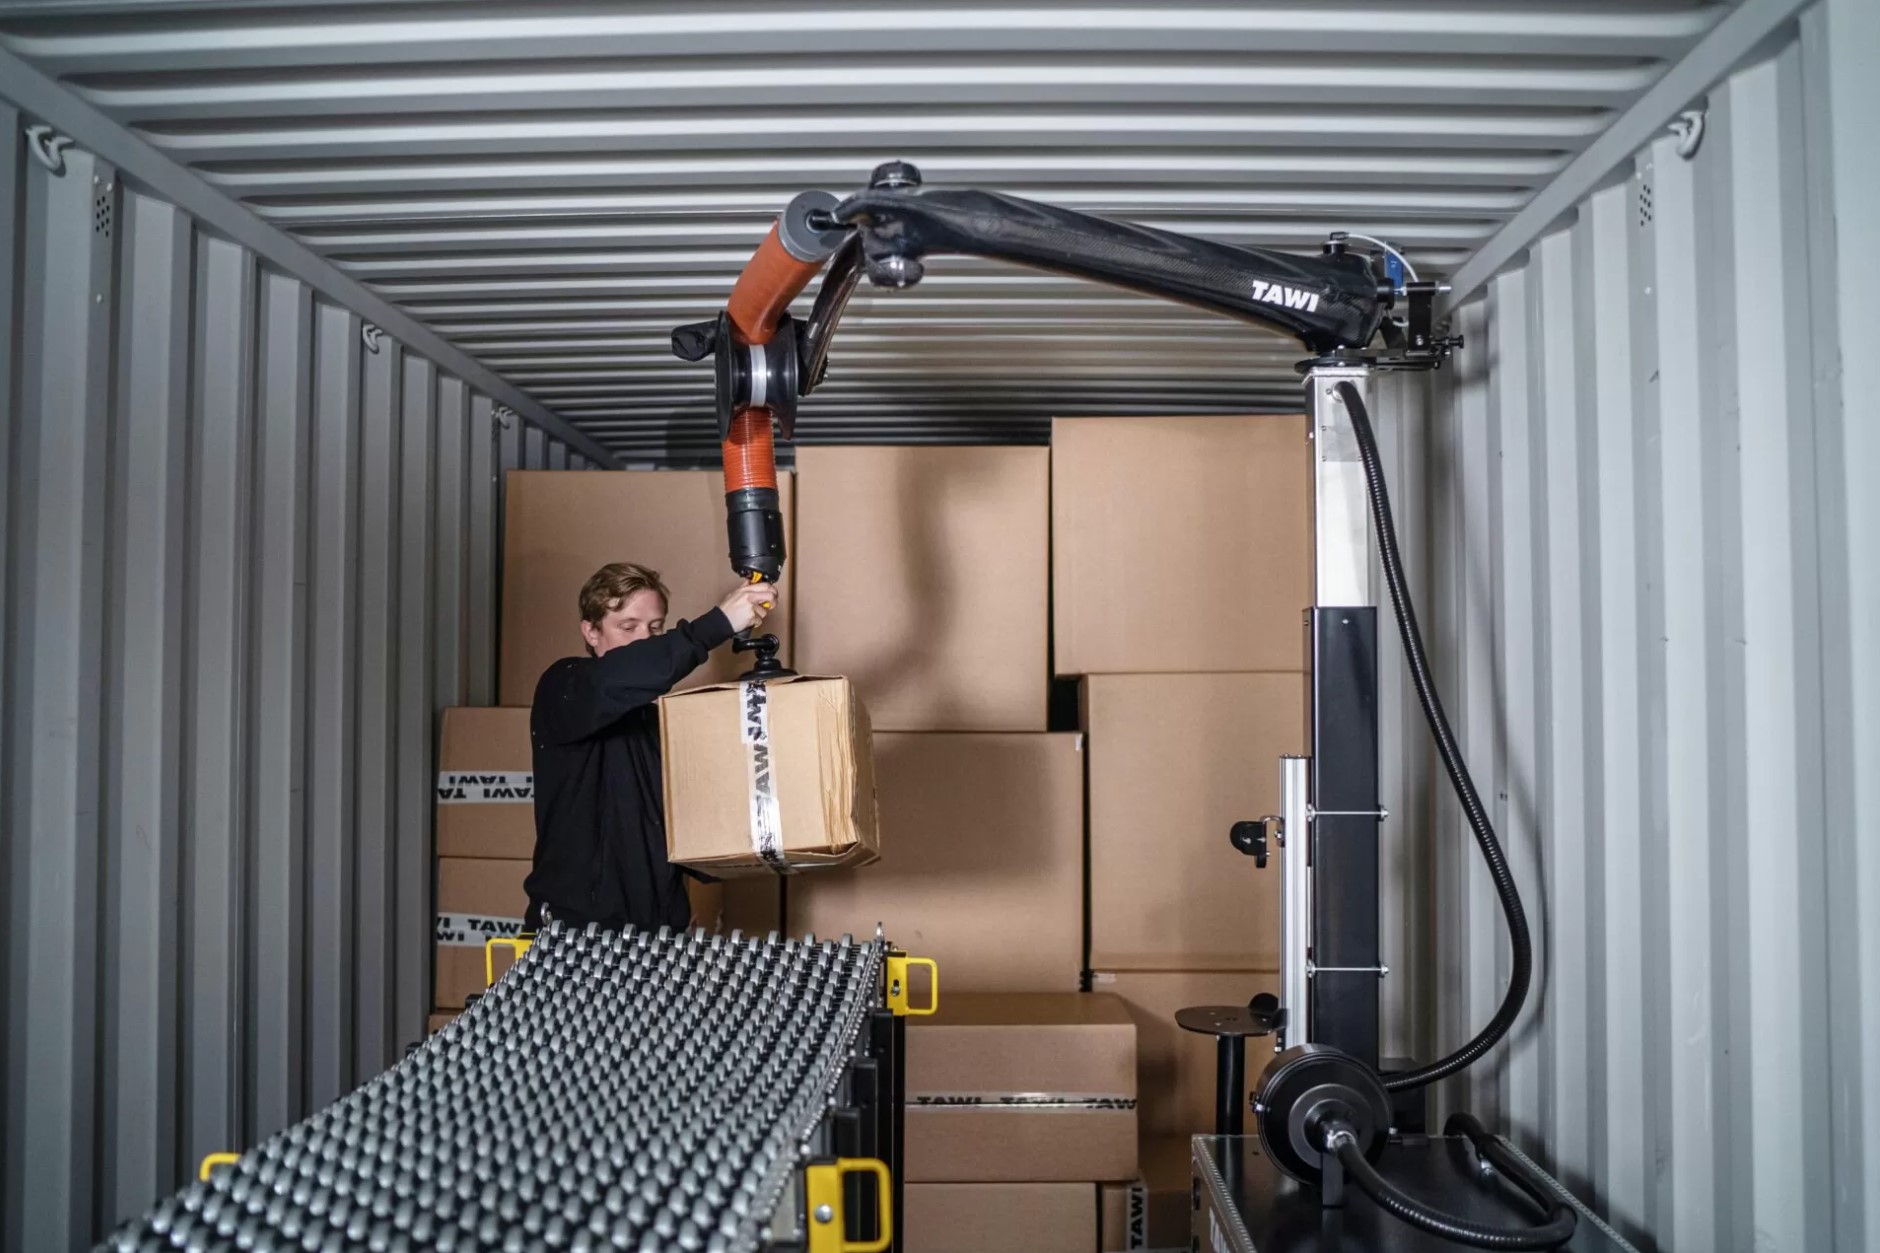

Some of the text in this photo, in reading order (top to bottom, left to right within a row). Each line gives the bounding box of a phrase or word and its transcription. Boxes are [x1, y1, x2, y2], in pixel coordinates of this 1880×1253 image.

[1252, 280, 1320, 313] TAWI
[483, 787, 535, 799] AWI
[467, 918, 523, 935] TAW
[1082, 1097, 1137, 1110] TAW
[1131, 1187, 1143, 1250] TAWI
